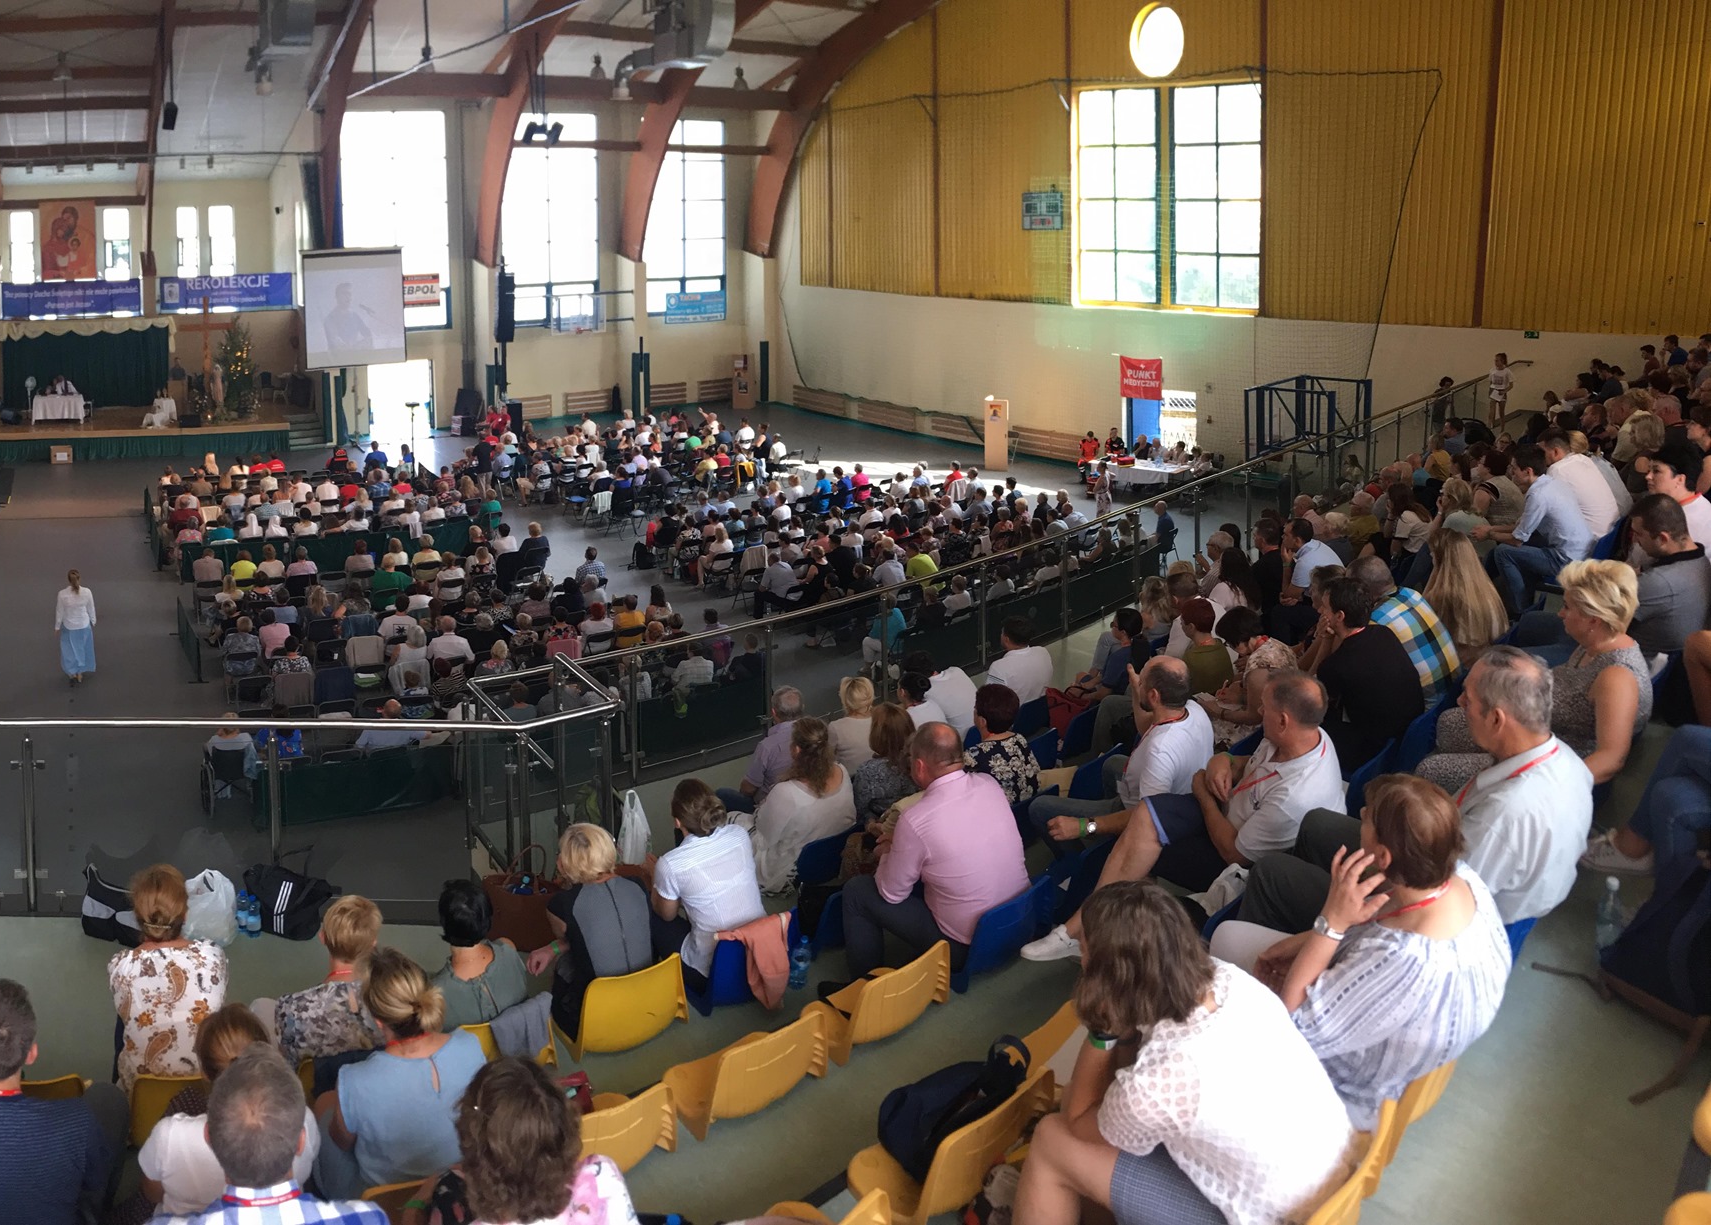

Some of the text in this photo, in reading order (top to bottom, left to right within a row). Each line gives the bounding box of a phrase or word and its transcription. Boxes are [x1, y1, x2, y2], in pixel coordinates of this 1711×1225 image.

[186, 275, 270, 290] REKOLEKCJE
[1127, 369, 1157, 379] PUNKT
[1123, 378, 1160, 388] MEDYCZNY
